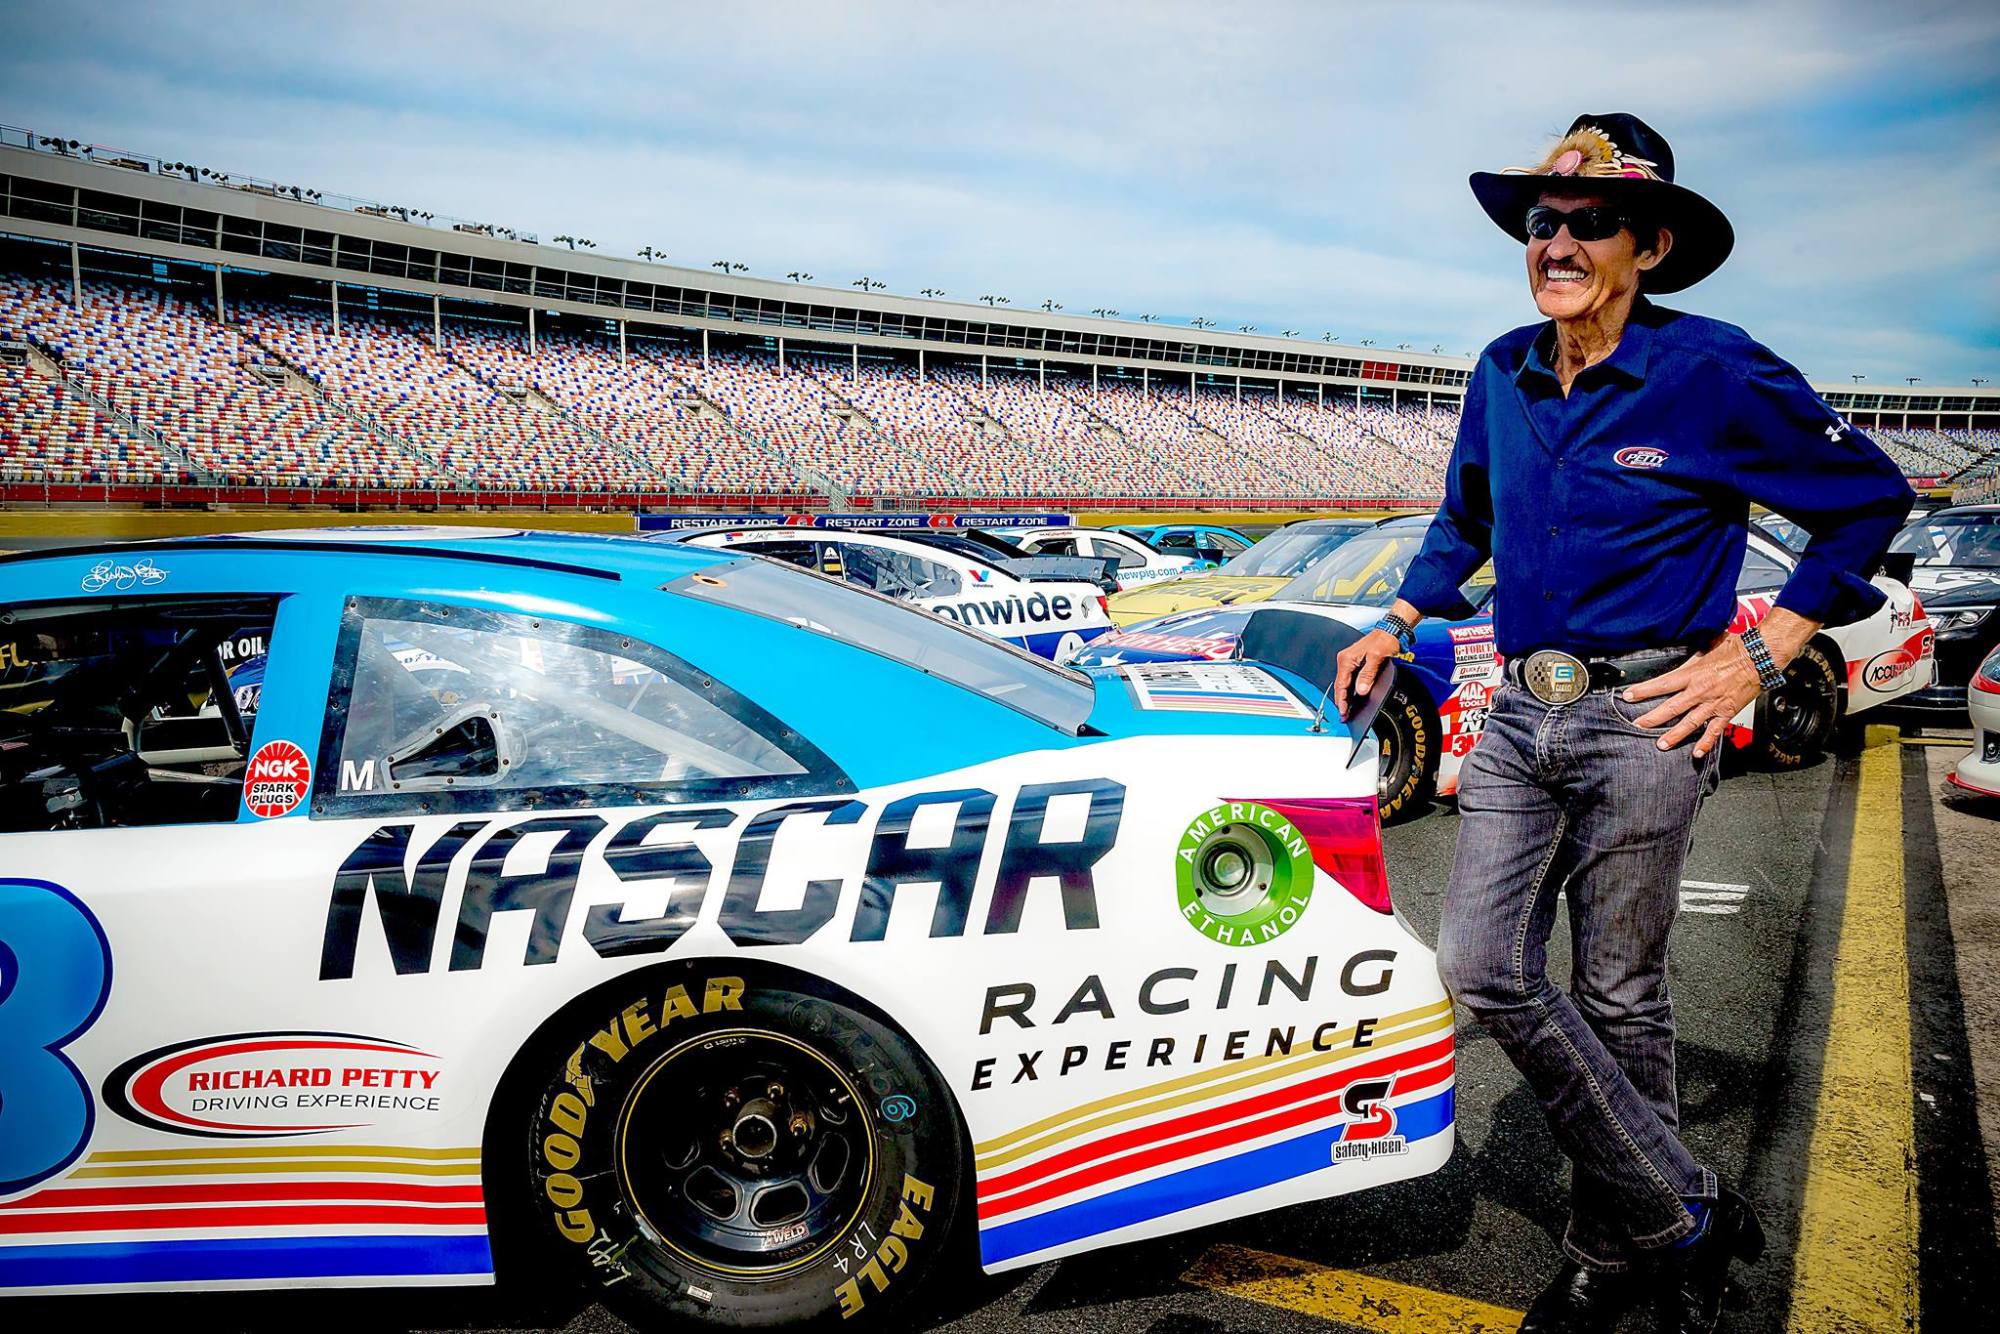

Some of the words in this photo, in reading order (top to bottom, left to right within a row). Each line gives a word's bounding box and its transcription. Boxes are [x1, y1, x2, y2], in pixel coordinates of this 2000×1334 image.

[825, 518, 883, 527] RESTART
[887, 518, 920, 527] ZONE
[961, 517, 1014, 526] RESTART
[1018, 517, 1048, 526] ZONE
[1117, 567, 1179, 580] newpig.com
[238, 636, 266, 657] OIL
[1459, 699, 1486, 708] TOOLS
[254, 758, 300, 778] NGK
[341, 760, 375, 791] M
[252, 783, 295, 793] SPARK
[251, 794, 294, 804] PLUGS
[1178, 802, 1308, 865] AMERICAN
[319, 776, 1127, 981] NASCAR
[1181, 895, 1309, 945] ETHANOL
[978, 949, 1398, 1036] RACING
[970, 1017, 1379, 1092] EXPERIENCE
[188, 1067, 332, 1092] RICHARD
[341, 1067, 441, 1090] PETTY
[191, 1094, 289, 1112] DRIVING
[296, 1093, 441, 1112] EXPERIENCE
[834, 1172, 935, 1320] EAGLE
